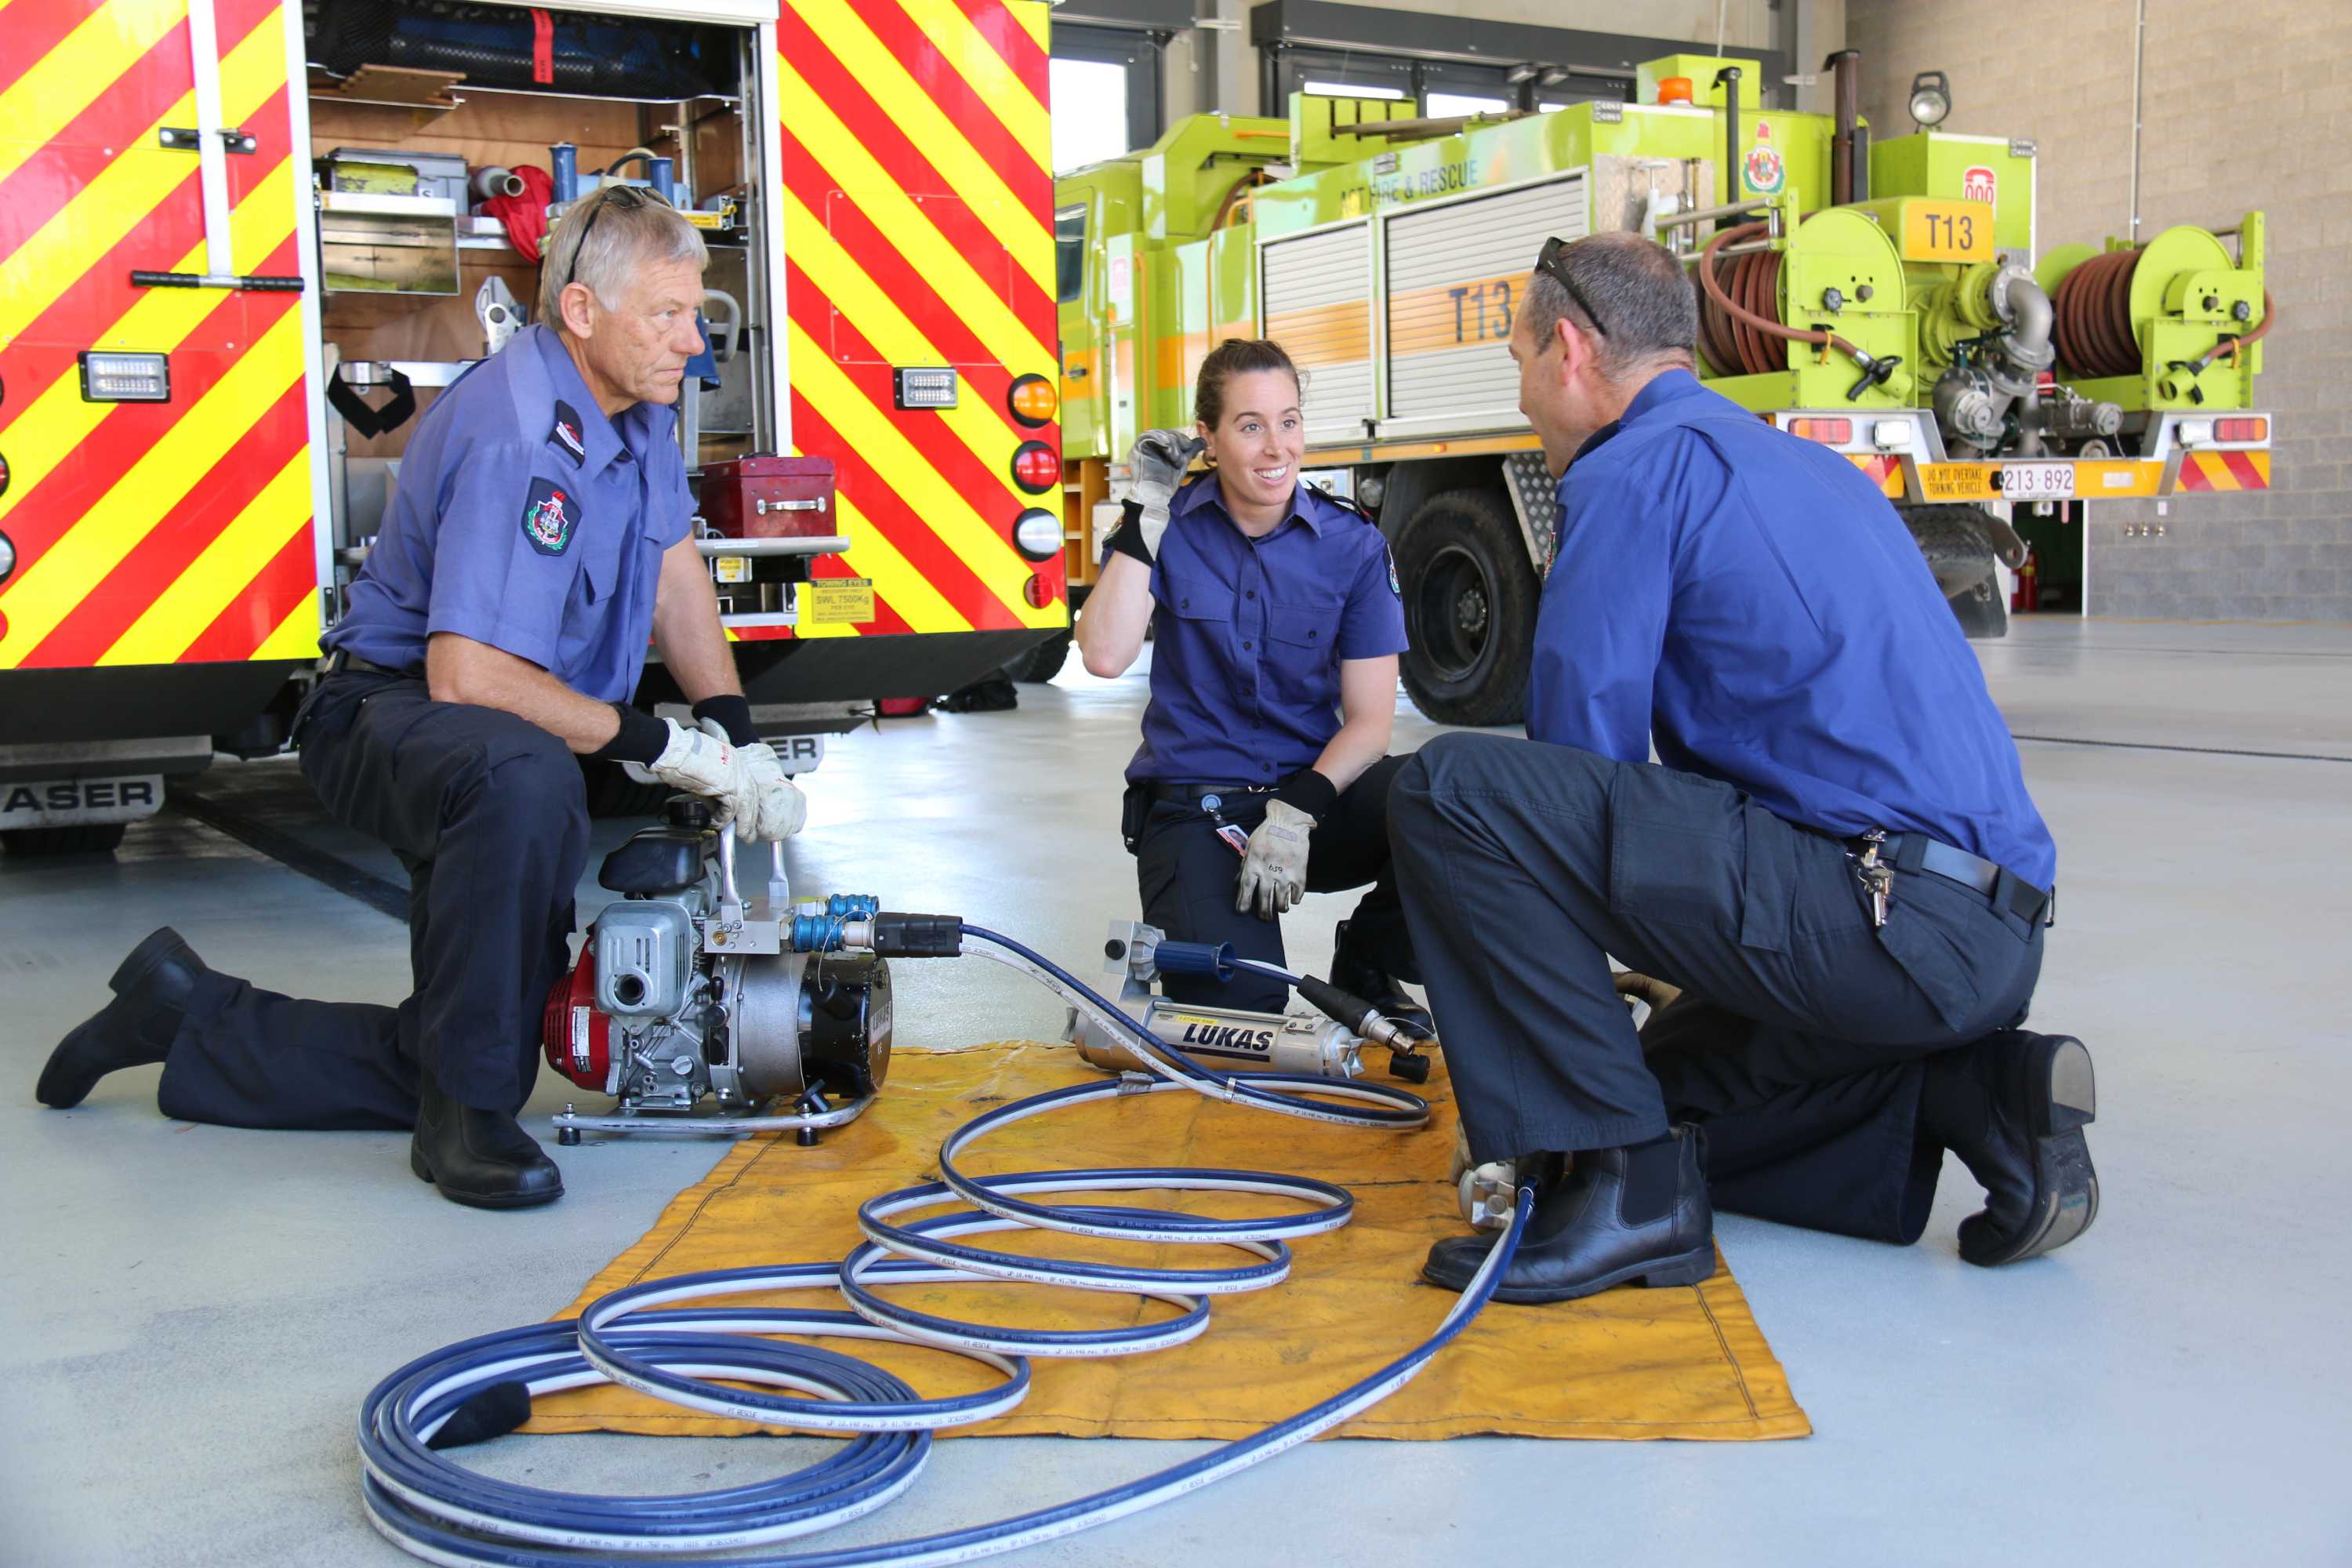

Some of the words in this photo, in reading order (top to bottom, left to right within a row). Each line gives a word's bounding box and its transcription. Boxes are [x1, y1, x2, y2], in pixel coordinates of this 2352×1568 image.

[1404, 175, 1414, 199] &
[1420, 159, 1479, 197] RESCUE
[1926, 213, 1973, 251] T13
[1448, 280, 1512, 343] T13
[1953, 466, 1983, 481] OVERTAKE
[1958, 480, 1981, 495] VEHICLE
[816, 596, 836, 604] SWL
[1183, 1023, 1273, 1051] LUKAS
